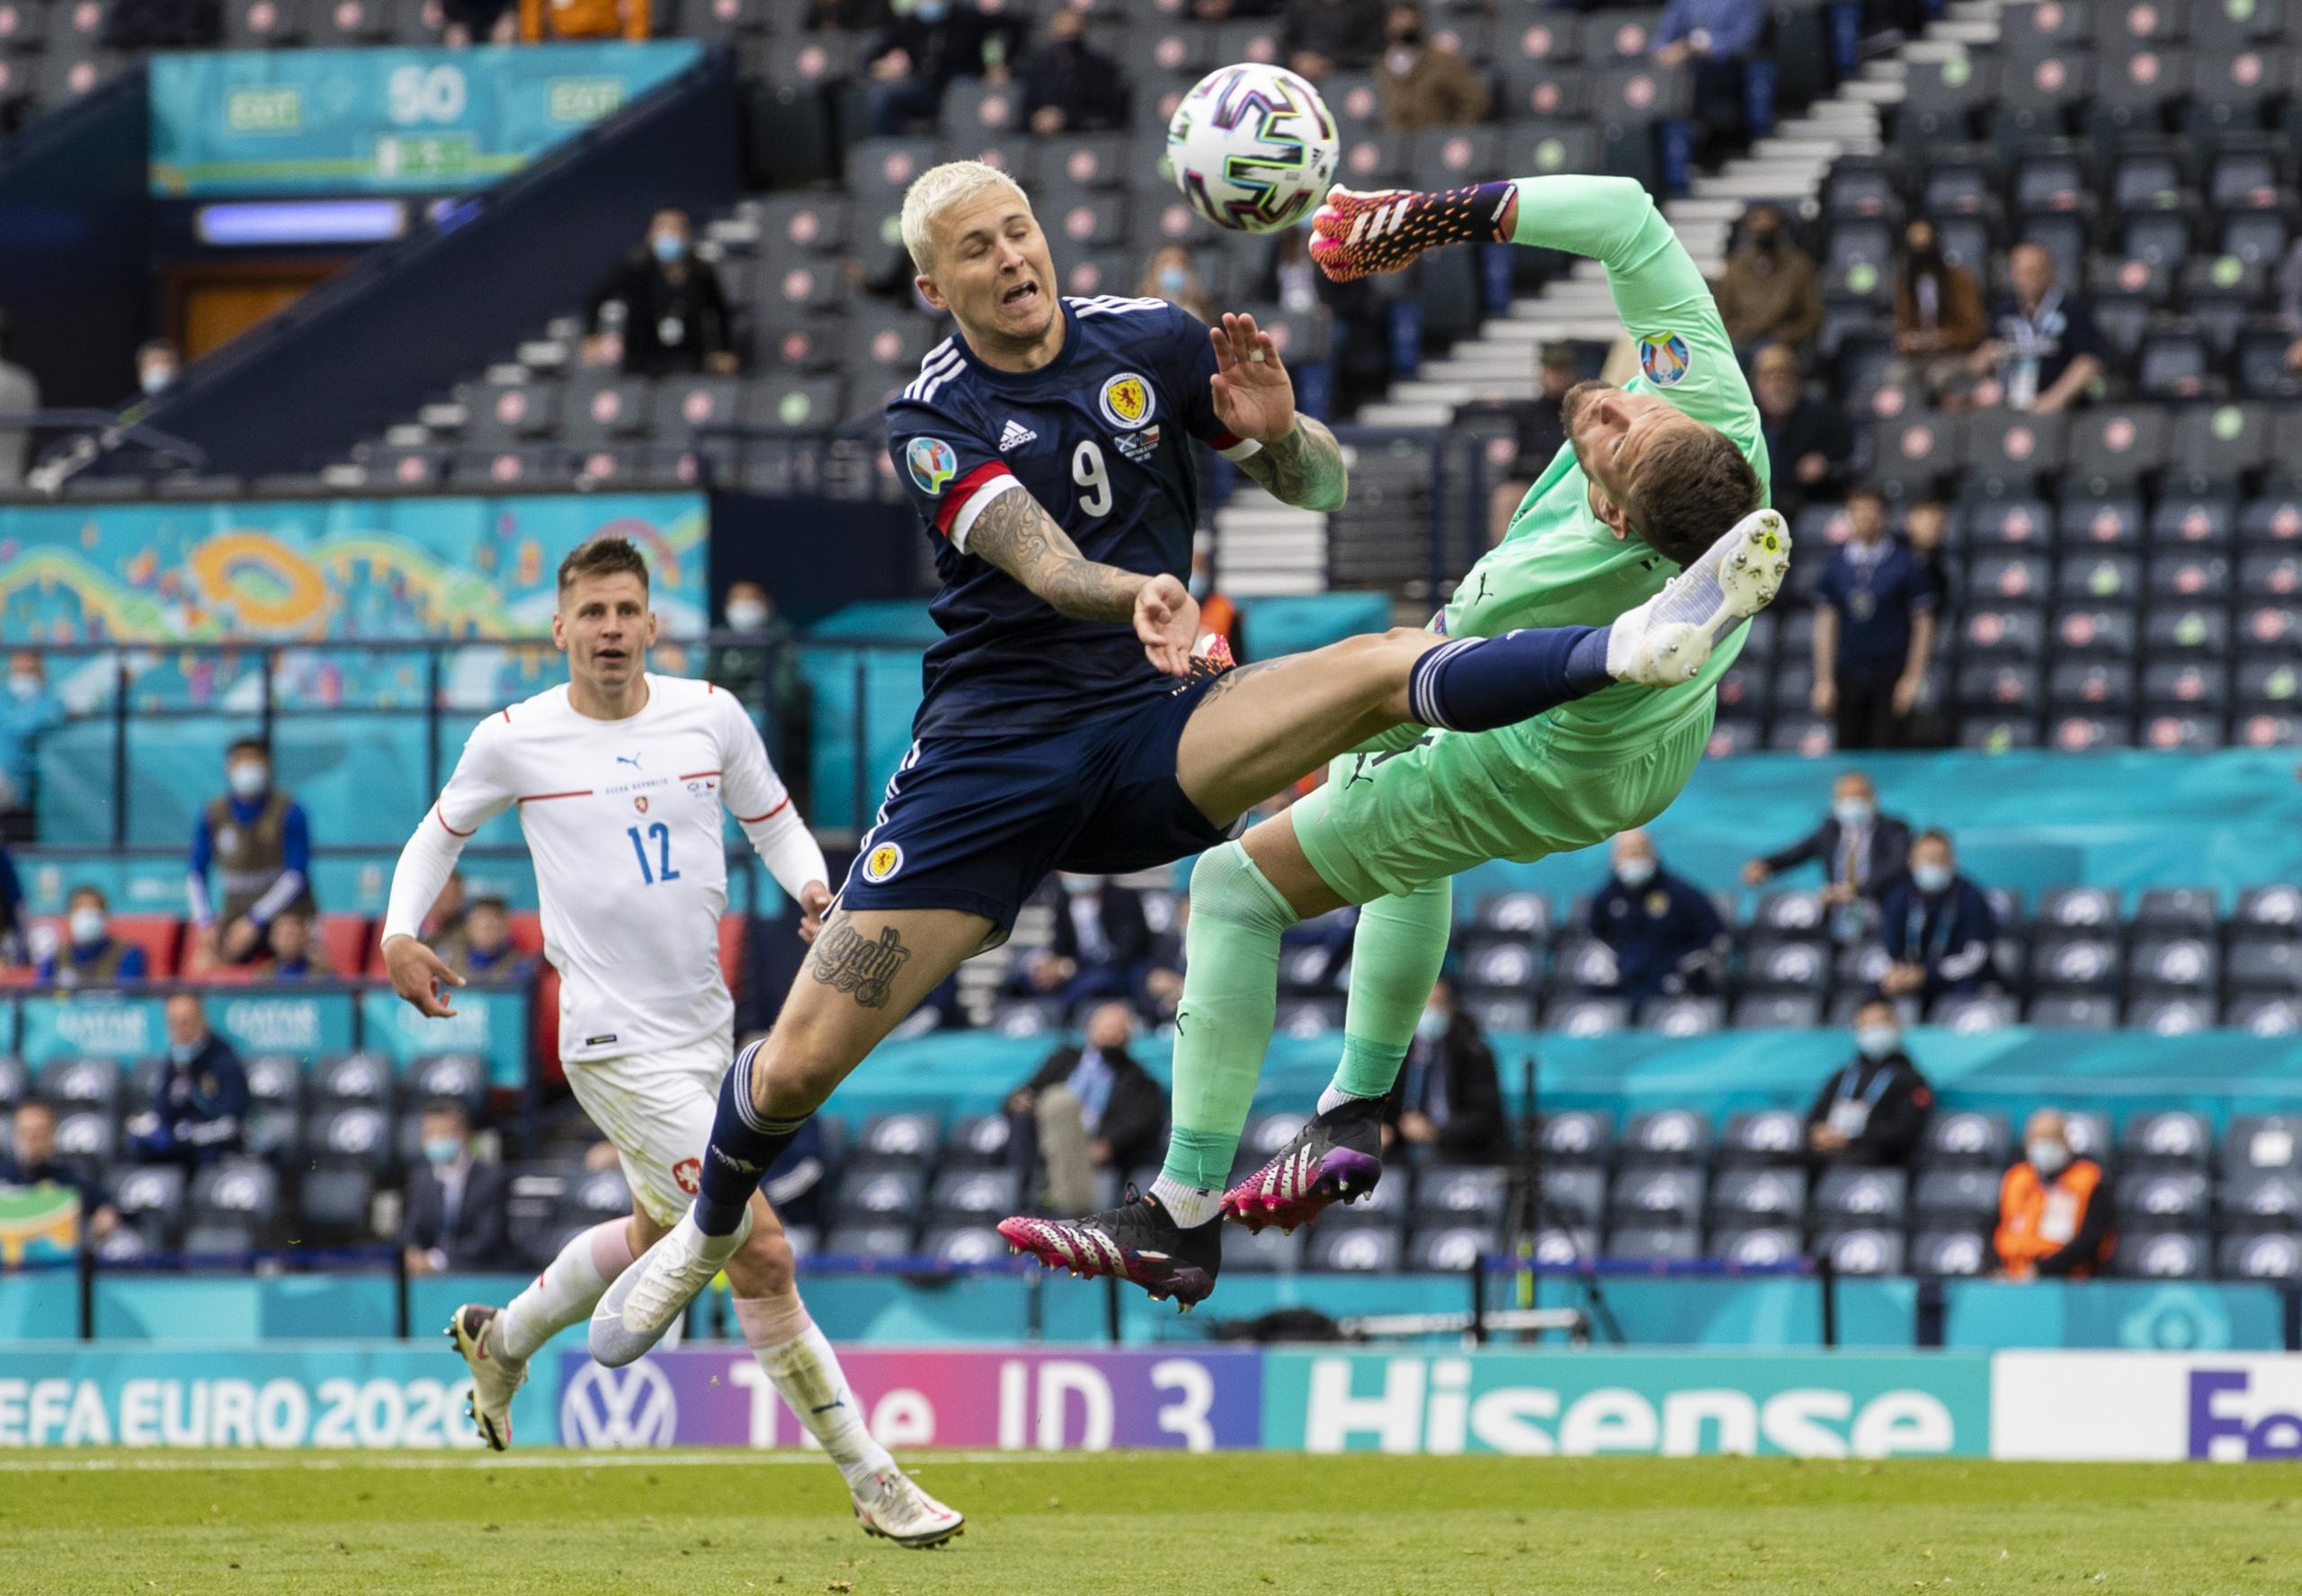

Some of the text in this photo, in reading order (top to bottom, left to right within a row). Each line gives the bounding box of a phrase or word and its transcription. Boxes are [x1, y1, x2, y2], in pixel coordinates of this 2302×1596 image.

[388, 64, 467, 124] 50
[998, 429, 1038, 452] adidas
[1073, 440, 1112, 517] 9
[626, 821, 681, 886] 12
[120, 1378, 308, 1447] EURO
[729, 1359, 1215, 1450] Te ID 3
[1304, 1359, 1955, 1456] Hisense
